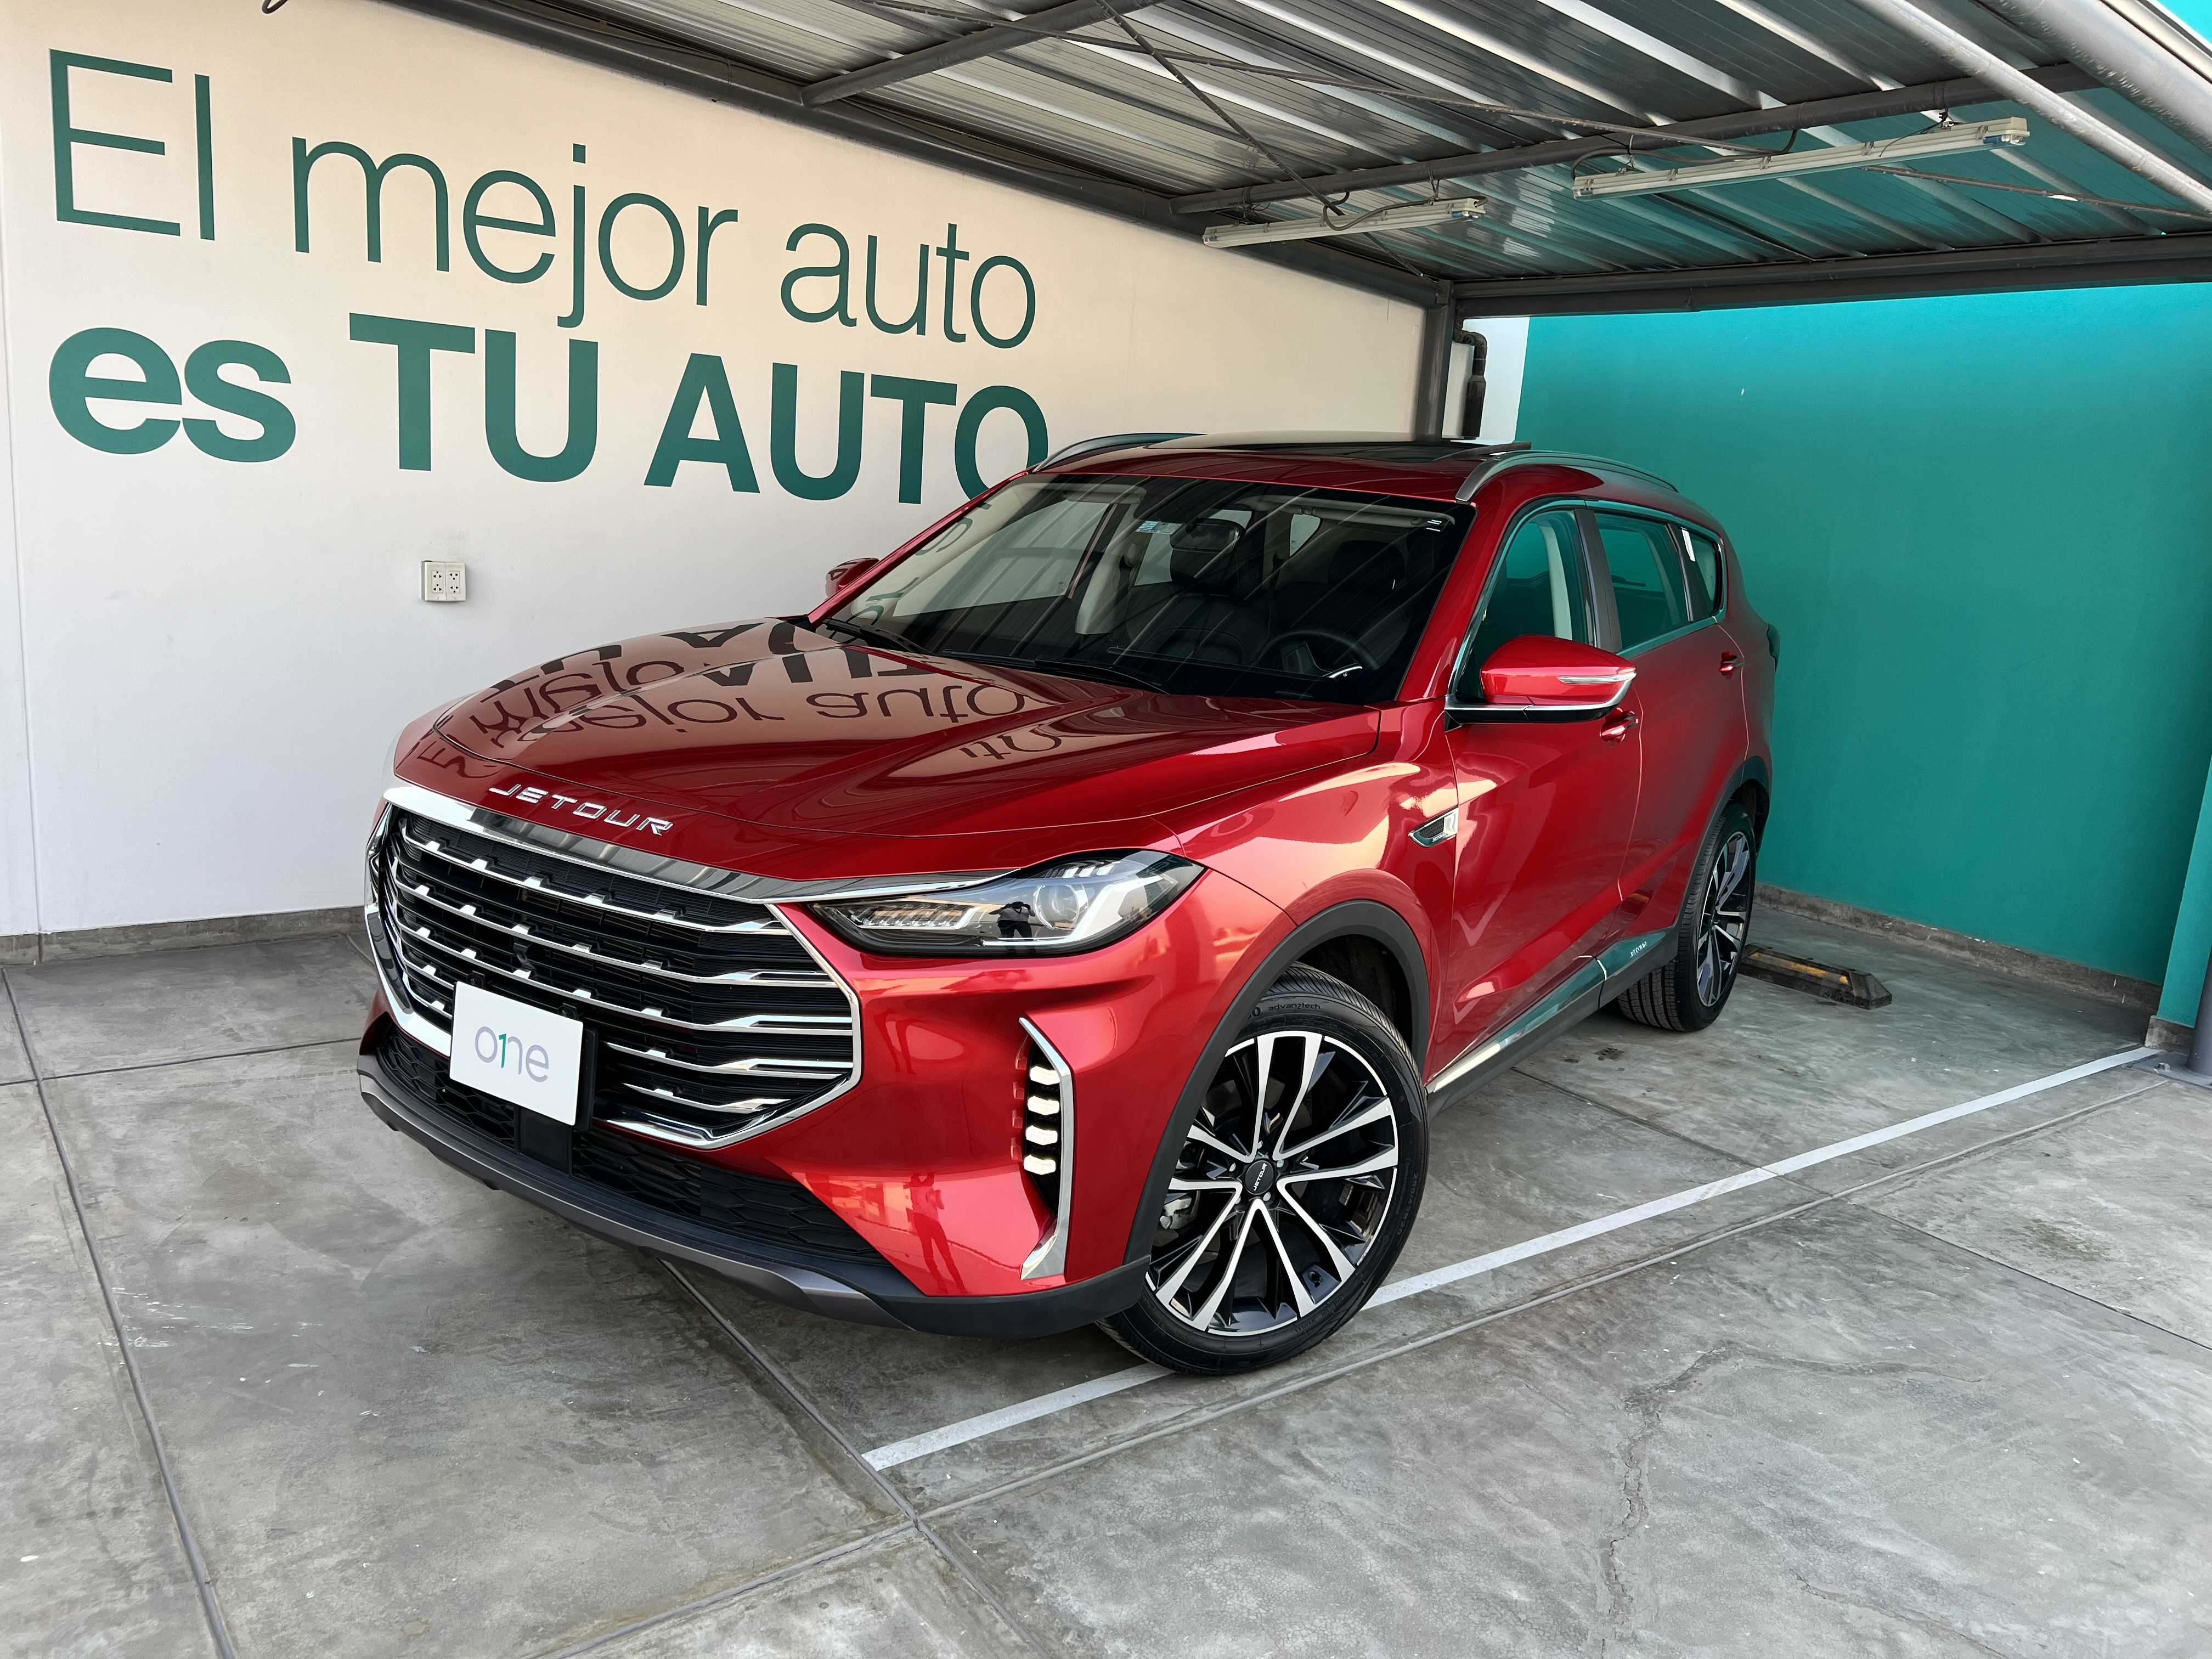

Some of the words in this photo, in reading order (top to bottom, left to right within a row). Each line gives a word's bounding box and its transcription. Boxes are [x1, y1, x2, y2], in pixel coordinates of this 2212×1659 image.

[51, 49, 215, 240] El
[292, 136, 738, 328] mejor
[781, 223, 1036, 348] auto
[49, 327, 296, 463] es
[350, 313, 598, 482] TU
[645, 354, 1048, 504] AUTO
[488, 783, 674, 836] JETOUR
[1268, 1002, 1321, 1011] advanztech
[1253, 1163, 1267, 1191] JETOUR
